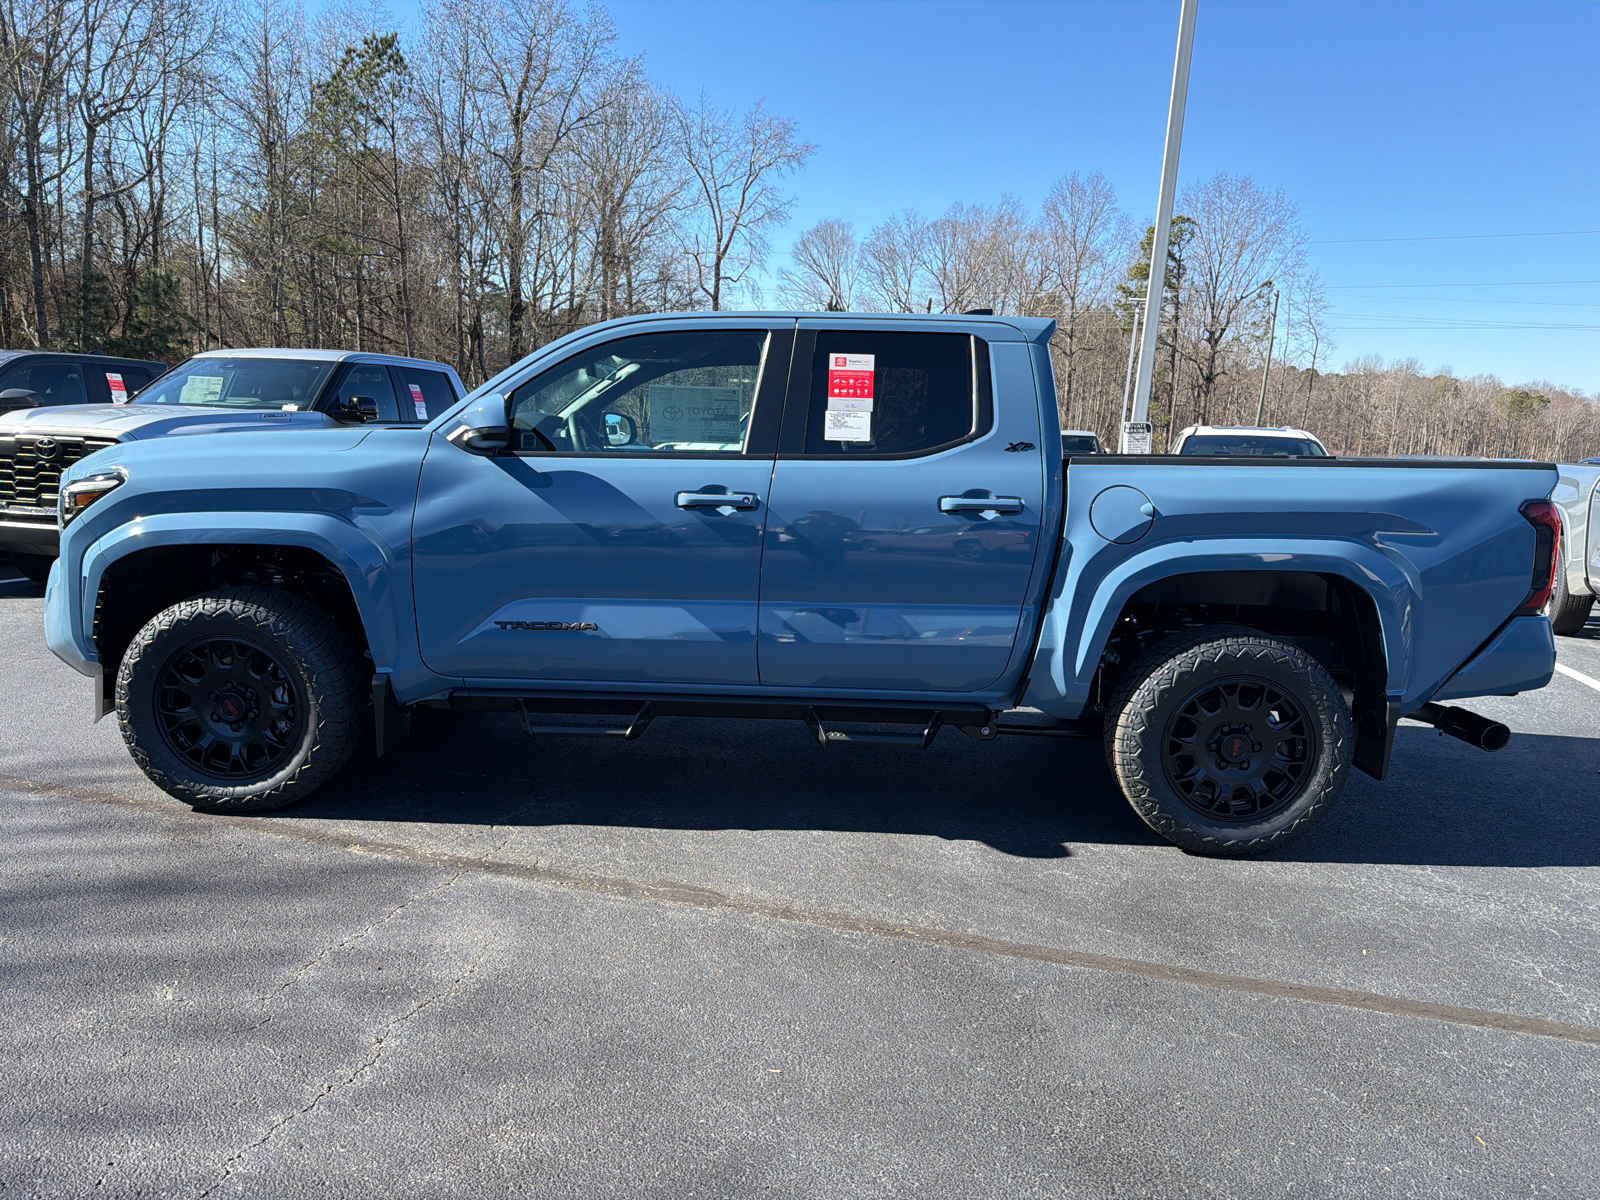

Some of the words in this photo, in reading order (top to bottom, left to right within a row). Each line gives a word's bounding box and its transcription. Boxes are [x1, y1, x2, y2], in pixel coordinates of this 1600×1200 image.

[686, 406, 728, 416] TOYOTA
[494, 620, 599, 631] TACOMA
[224, 698, 238, 715] TRD
[1232, 738, 1241, 757] TRD
